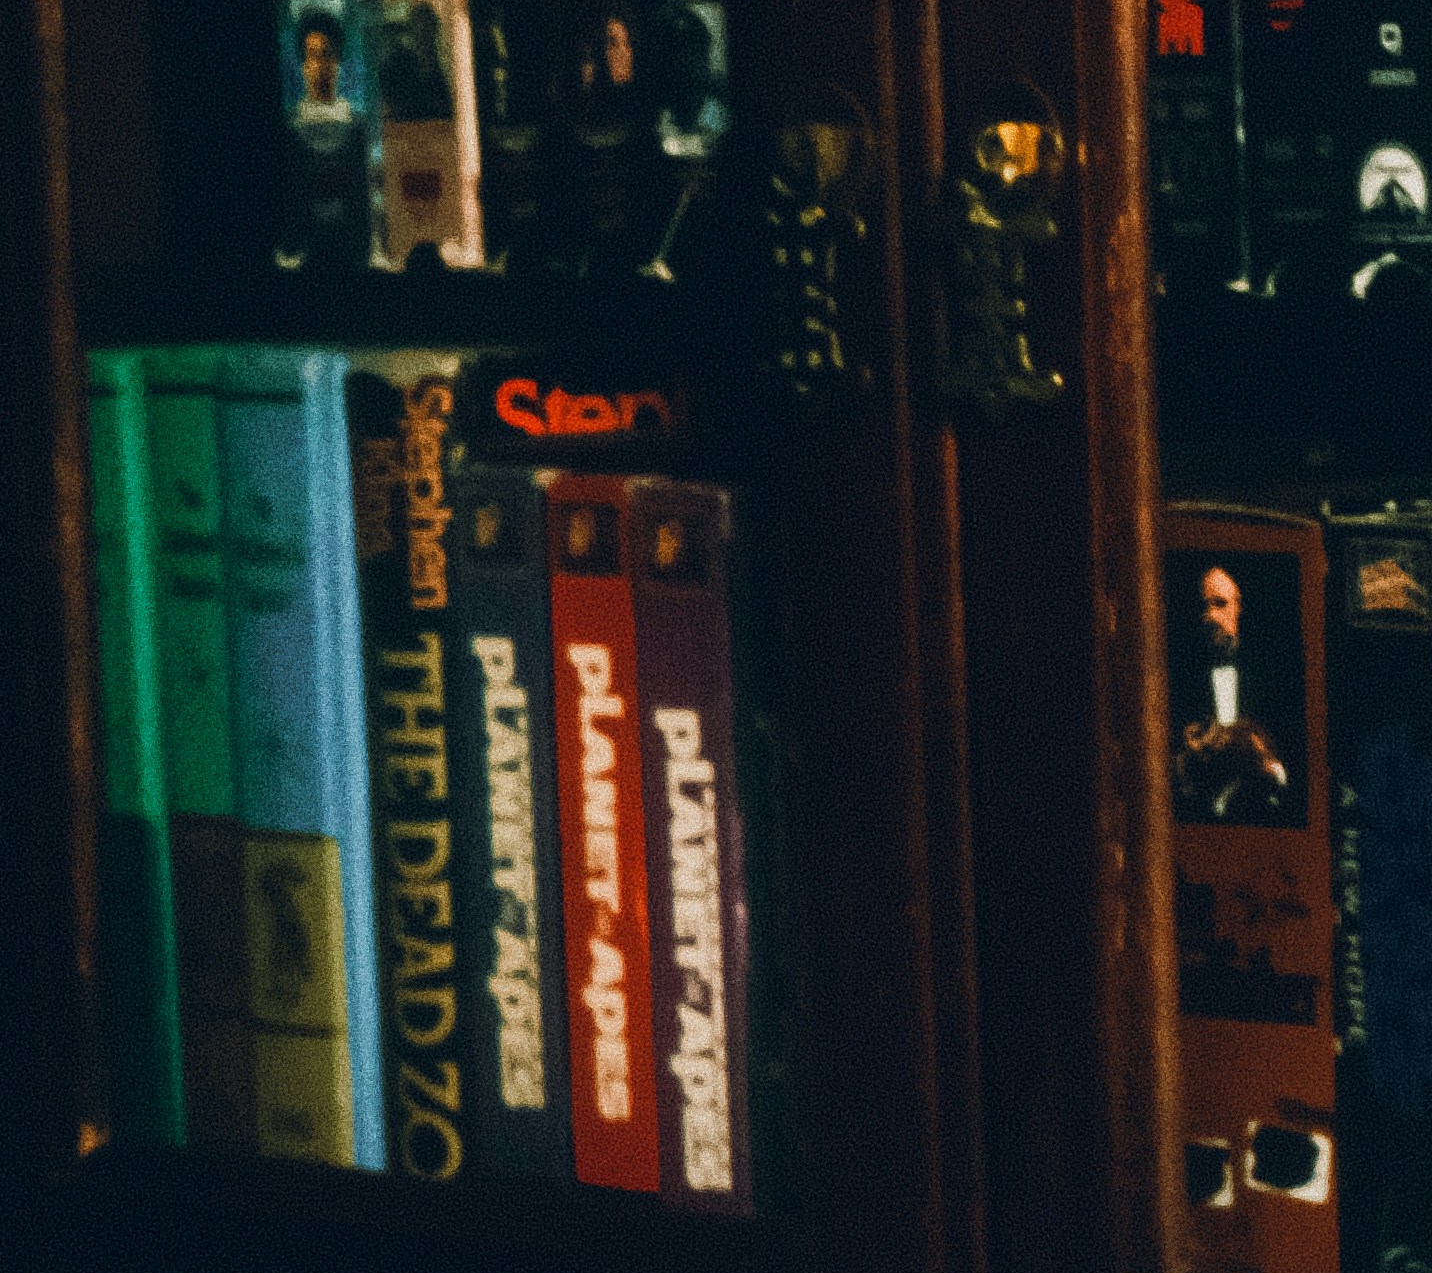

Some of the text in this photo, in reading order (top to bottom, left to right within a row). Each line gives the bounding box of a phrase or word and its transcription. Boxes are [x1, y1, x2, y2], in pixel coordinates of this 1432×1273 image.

[402, 377, 456, 611] Stephen
[377, 631, 463, 1181] THE DEAD ZO
